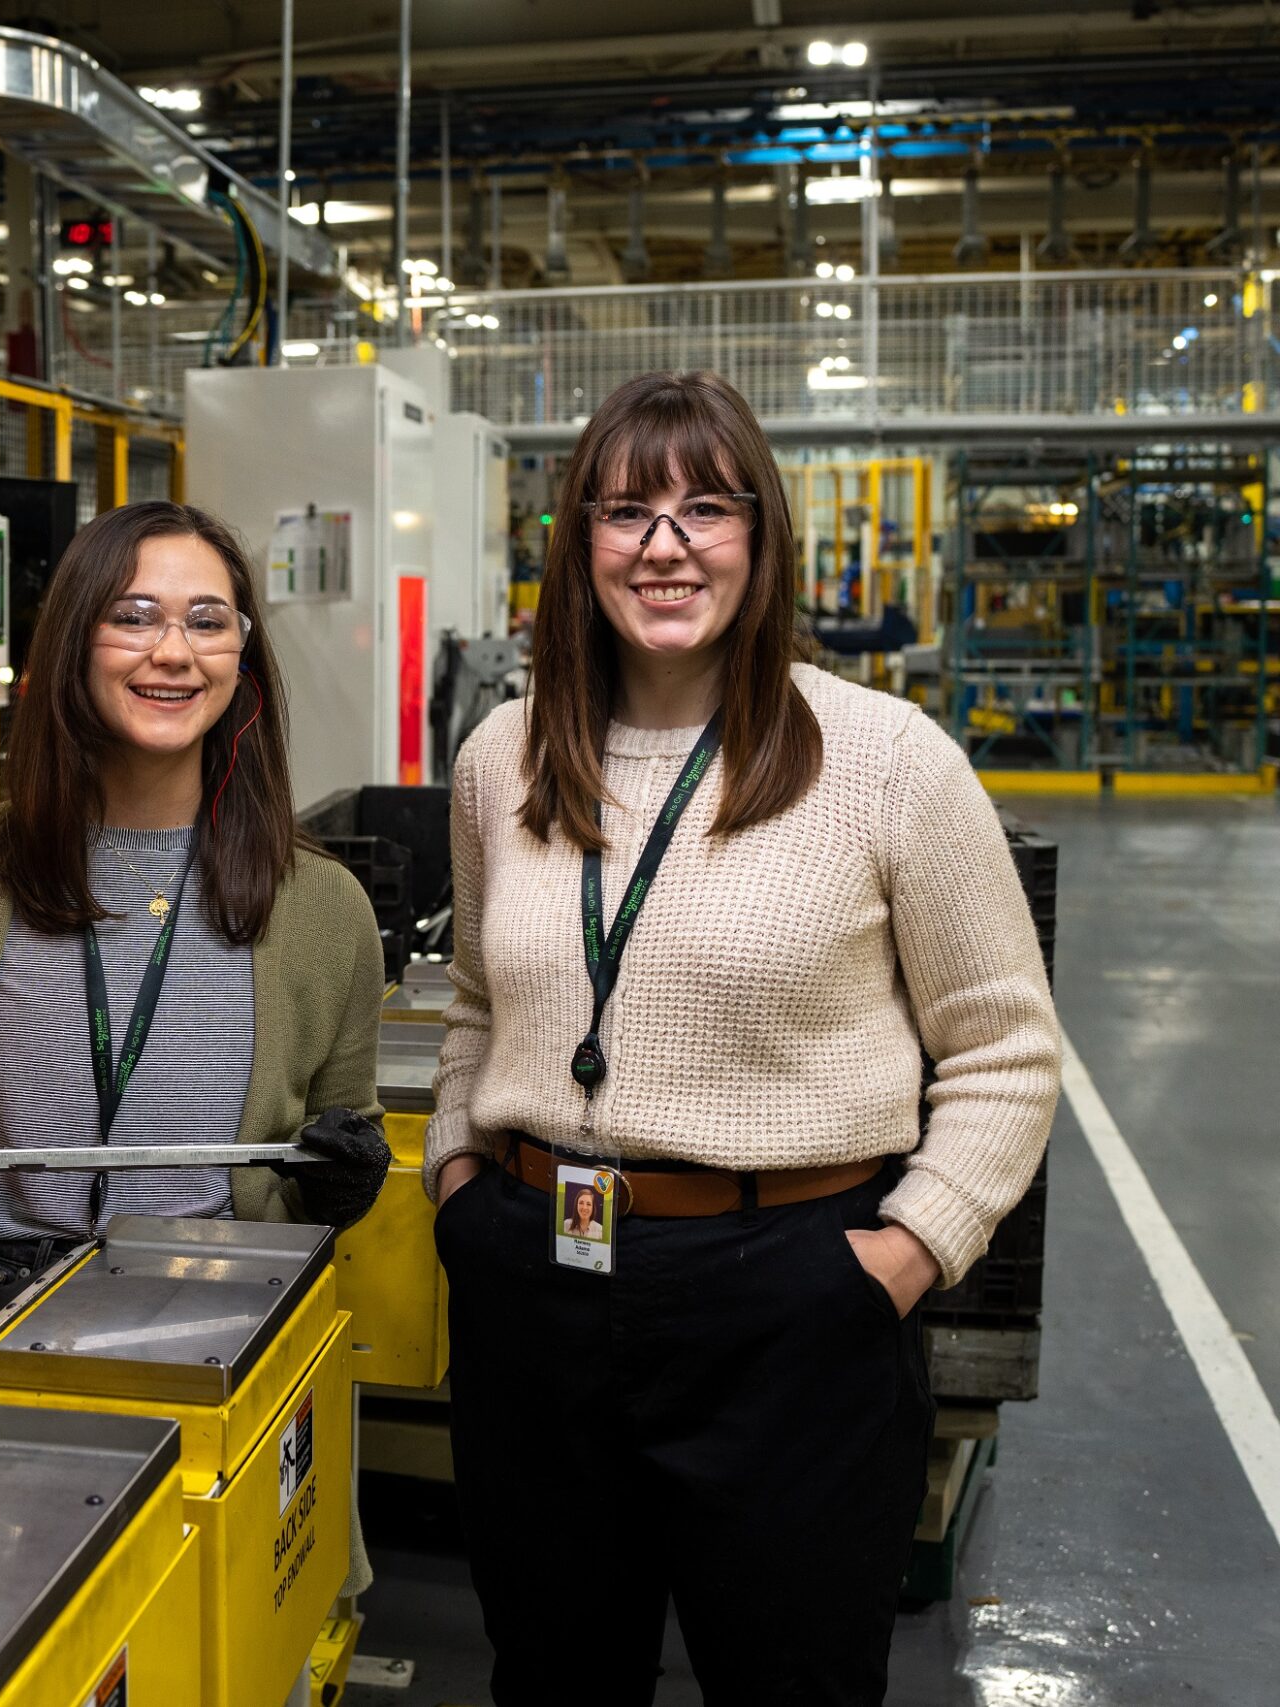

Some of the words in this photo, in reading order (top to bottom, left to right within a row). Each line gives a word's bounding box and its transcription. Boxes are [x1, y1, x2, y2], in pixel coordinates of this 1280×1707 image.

[674, 793, 684, 804] On
[681, 748, 706, 788] Schneider
[621, 876, 644, 919] Schneider
[589, 917, 600, 961] Schneider
[94, 1008, 105, 1052] Schneider
[274, 1506, 297, 1573] BACK
[299, 1474, 316, 1530] SIDE
[274, 1576, 287, 1615] TOP
[287, 1525, 315, 1591] ENDWALL
